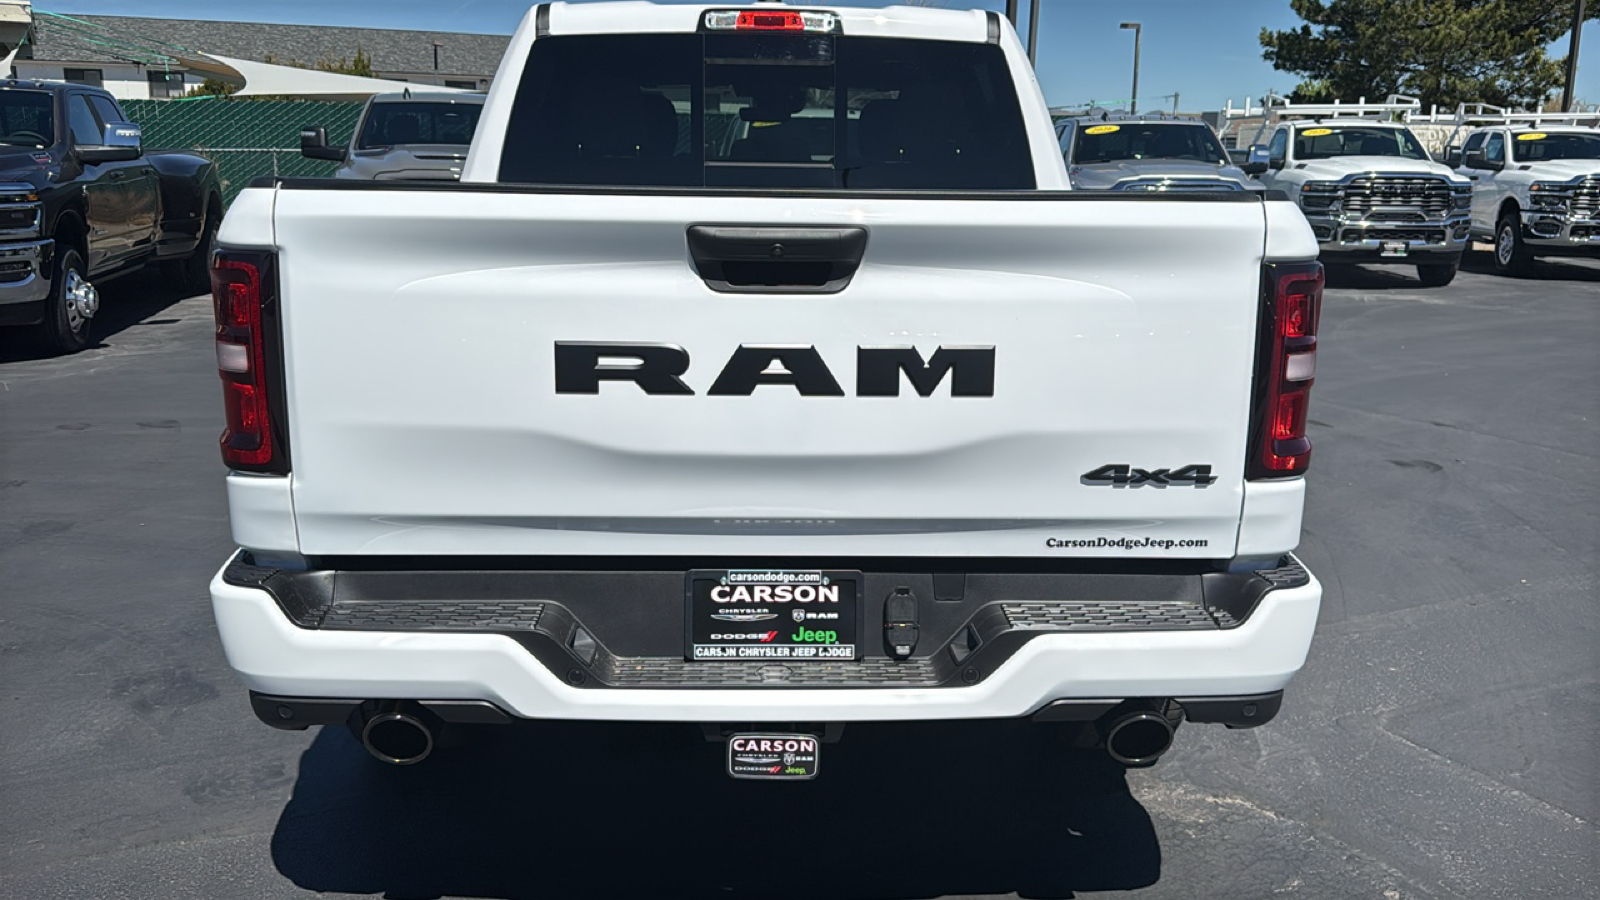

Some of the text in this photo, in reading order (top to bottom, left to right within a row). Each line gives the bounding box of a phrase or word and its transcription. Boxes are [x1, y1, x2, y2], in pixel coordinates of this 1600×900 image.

[554, 341, 996, 397] RAM
[1080, 464, 1218, 489] 4x4
[1046, 537, 1208, 549] CarsonDodgeJeep.com
[730, 572, 820, 583] carsondodge.com
[710, 585, 839, 602] CARSON
[791, 626, 837, 644] Jeep
[738, 647, 790, 657] CHRYSLER
[791, 647, 817, 657] JEEP
[733, 740, 814, 751] CARSON
